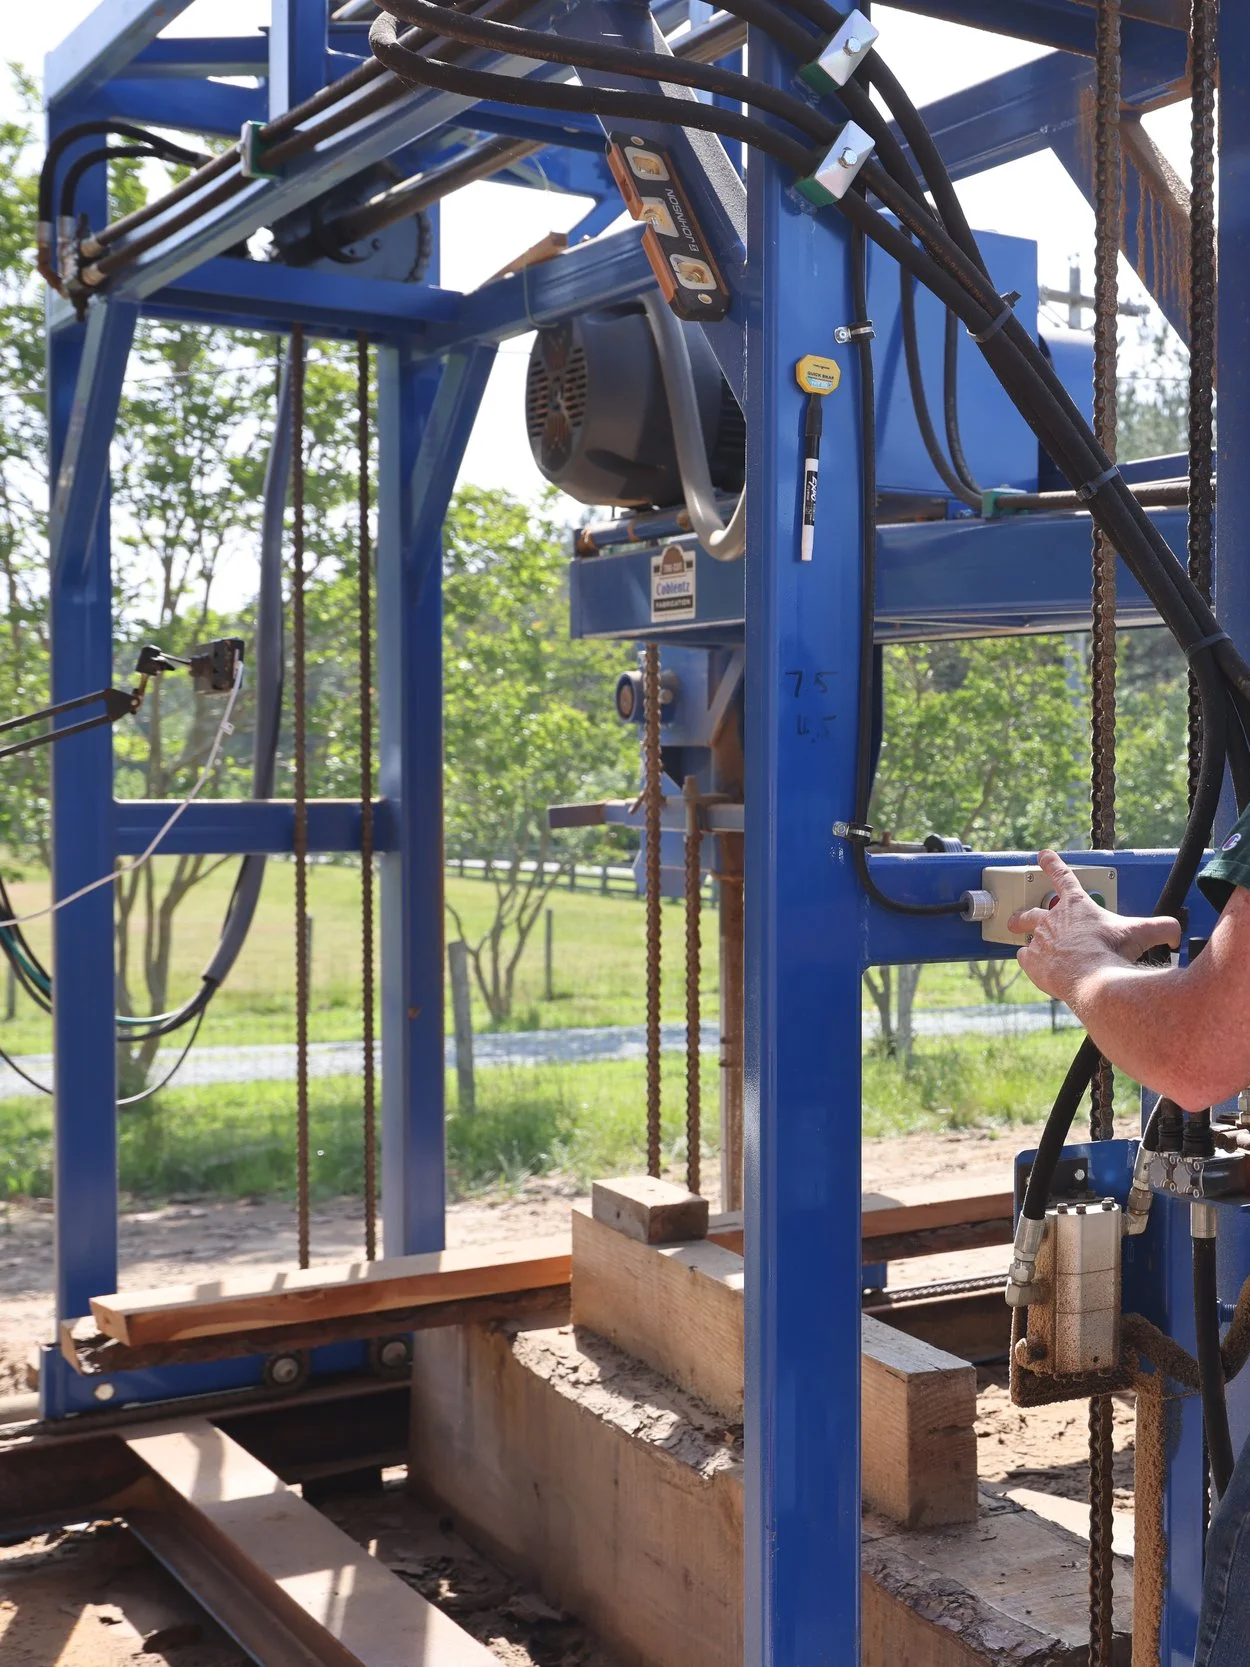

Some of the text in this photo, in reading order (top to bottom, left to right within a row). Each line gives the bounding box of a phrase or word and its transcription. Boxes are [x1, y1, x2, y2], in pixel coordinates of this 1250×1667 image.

[664, 188, 696, 244] JOHNSON
[808, 476, 818, 502] EXPO
[656, 581, 690, 597] Coblentz
